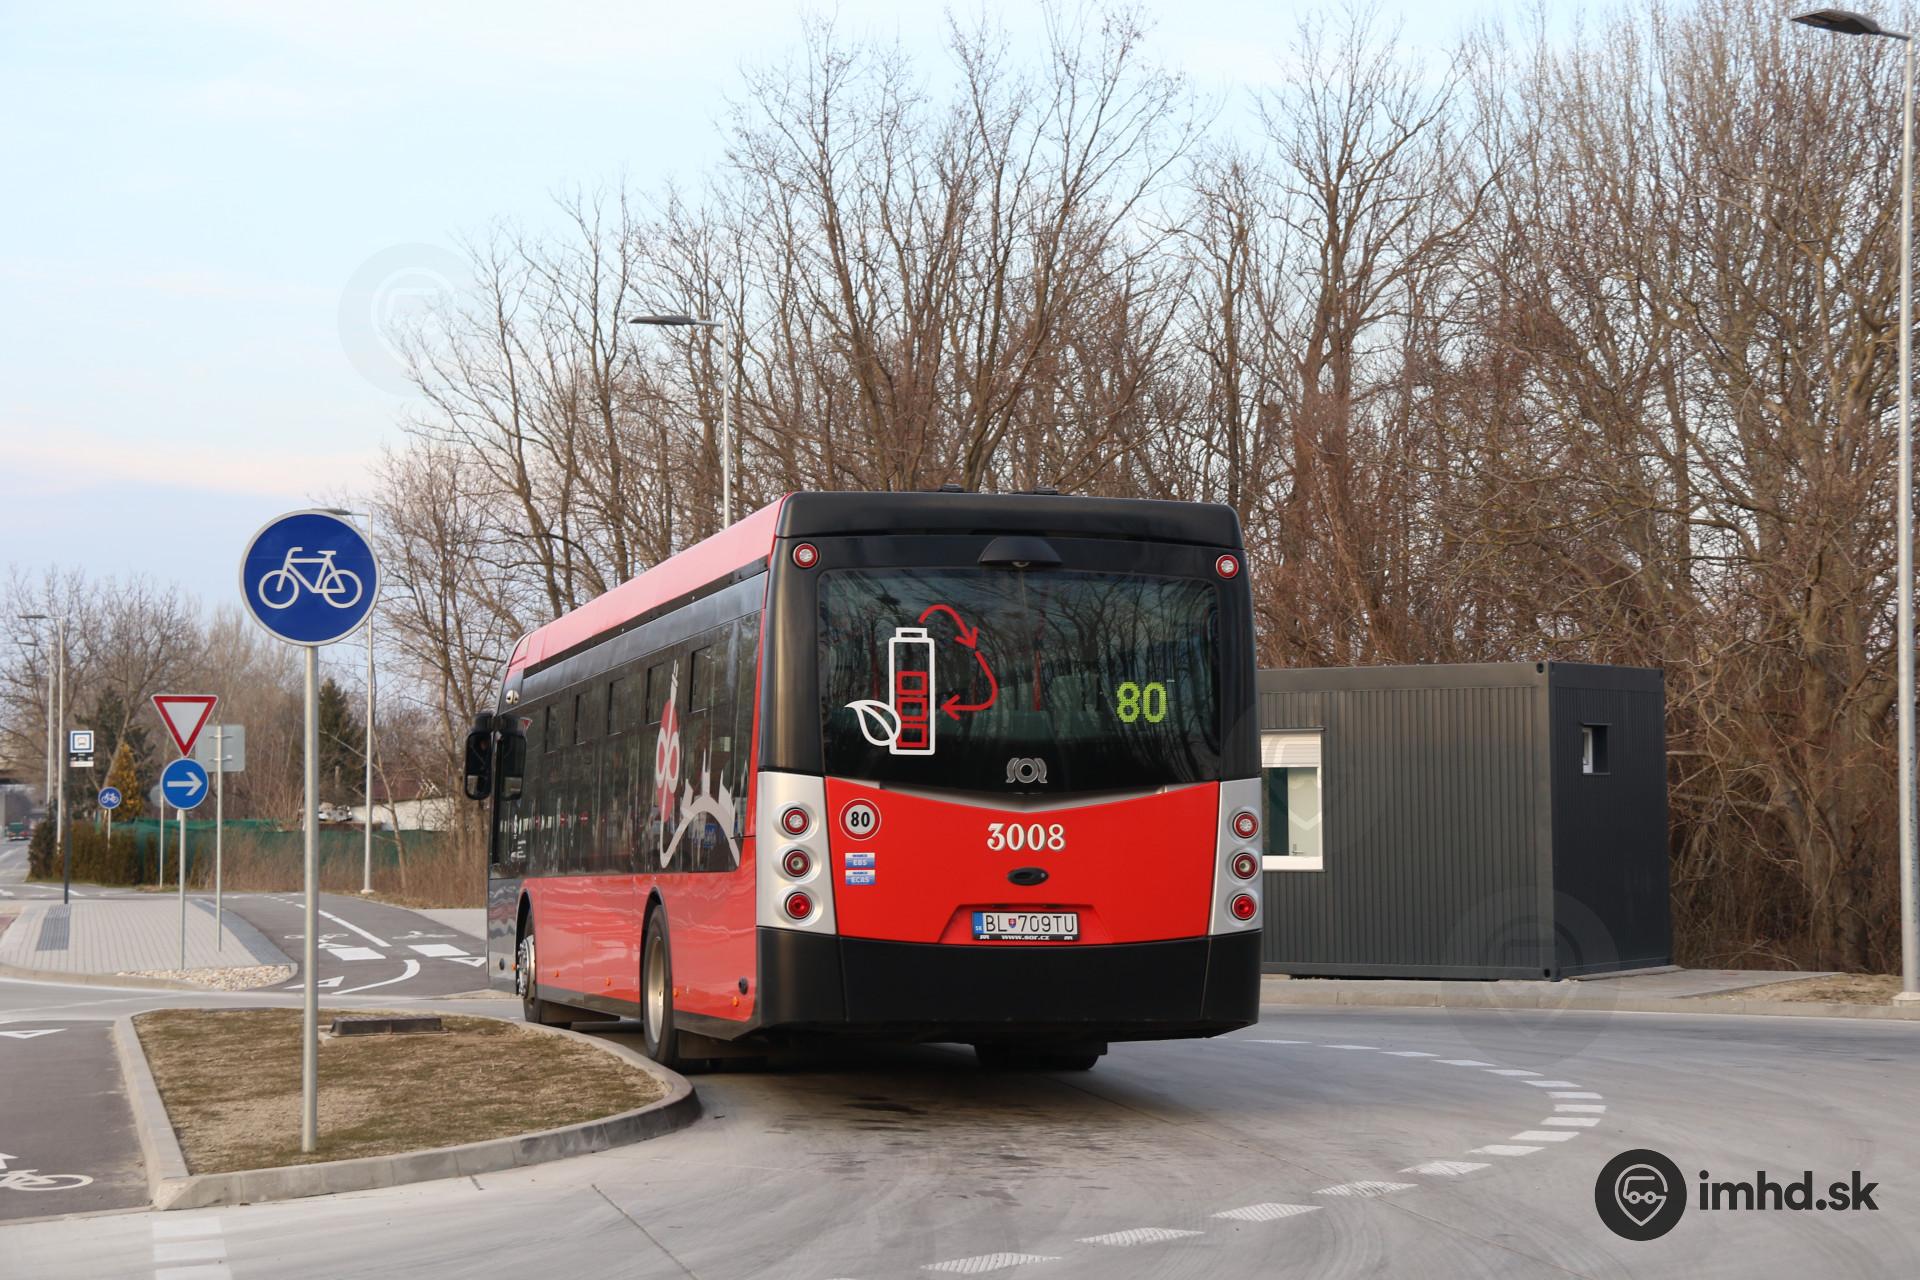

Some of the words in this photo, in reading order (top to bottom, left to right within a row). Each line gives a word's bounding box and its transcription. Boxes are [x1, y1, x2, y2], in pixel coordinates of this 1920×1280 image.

[1117, 682, 1166, 722] 80
[850, 811, 871, 828] 80
[987, 823, 1066, 851] 3008
[985, 915, 1008, 932] BL
[1018, 915, 1074, 932] 709TU
